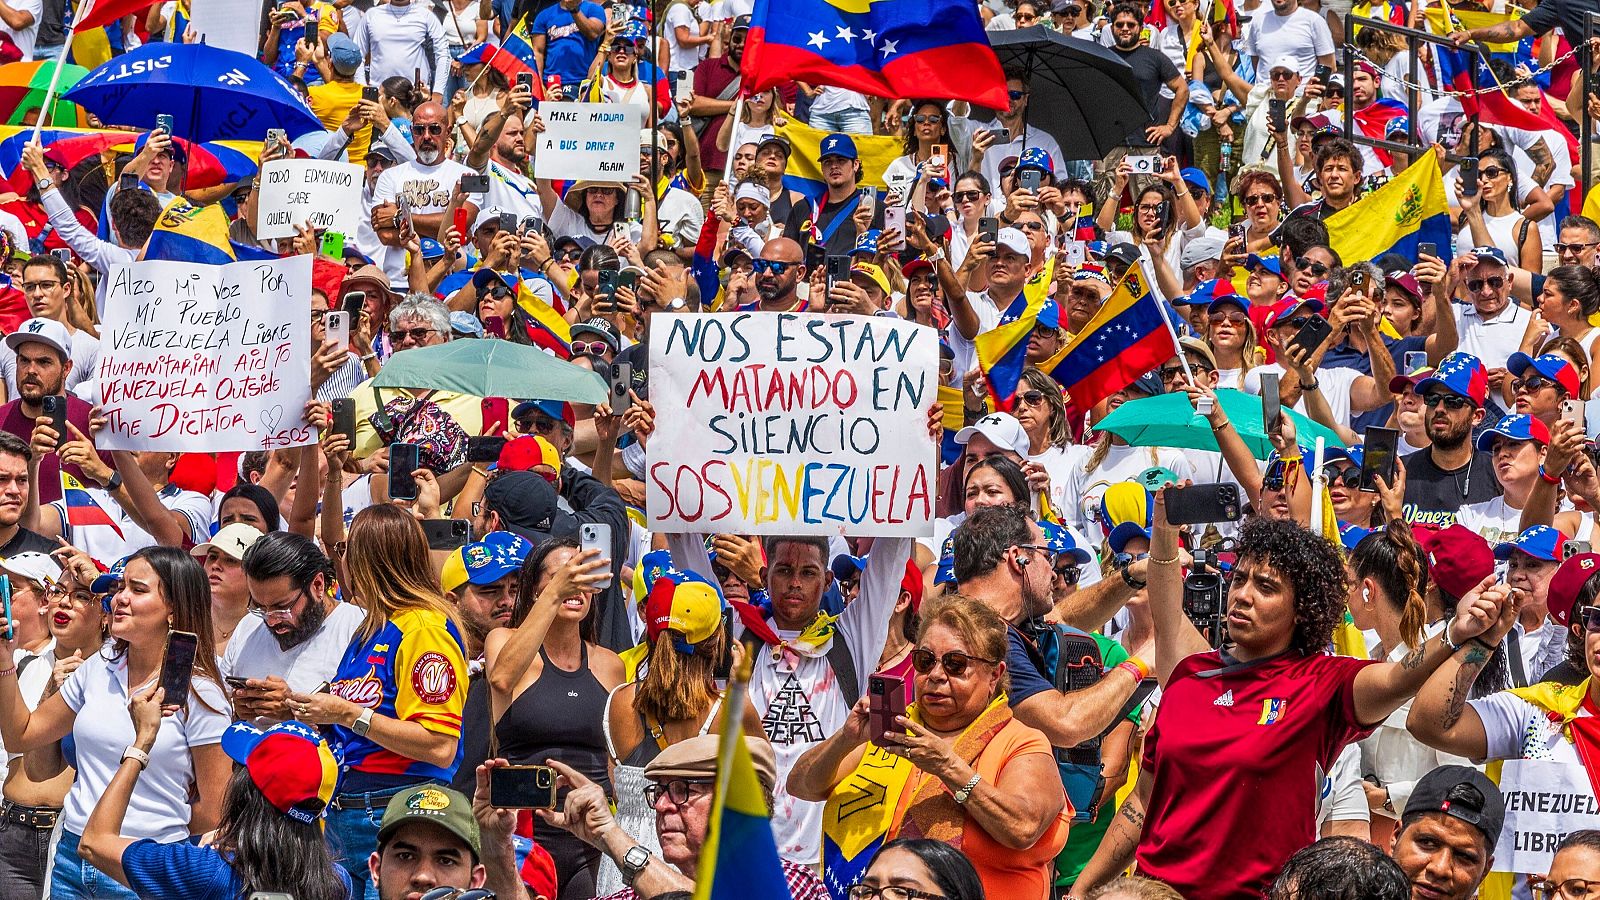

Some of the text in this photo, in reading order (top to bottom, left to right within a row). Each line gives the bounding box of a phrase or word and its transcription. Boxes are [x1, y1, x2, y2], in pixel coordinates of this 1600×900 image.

[550, 111, 624, 122] MAKE MADURO
[546, 140, 615, 151] A BUS DRIVER
[599, 161, 625, 172] AGAIN
[269, 168, 352, 188] TODO EDMUNDO
[287, 191, 311, 205] SABE
[113, 321, 230, 350] VENEZUELA
[665, 313, 919, 362] NOS ESTAN
[101, 377, 208, 406] VENEZUELA
[686, 363, 925, 413] MATANDO EN
[261, 424, 312, 450] #SOS
[568, 689, 579, 697] alo
